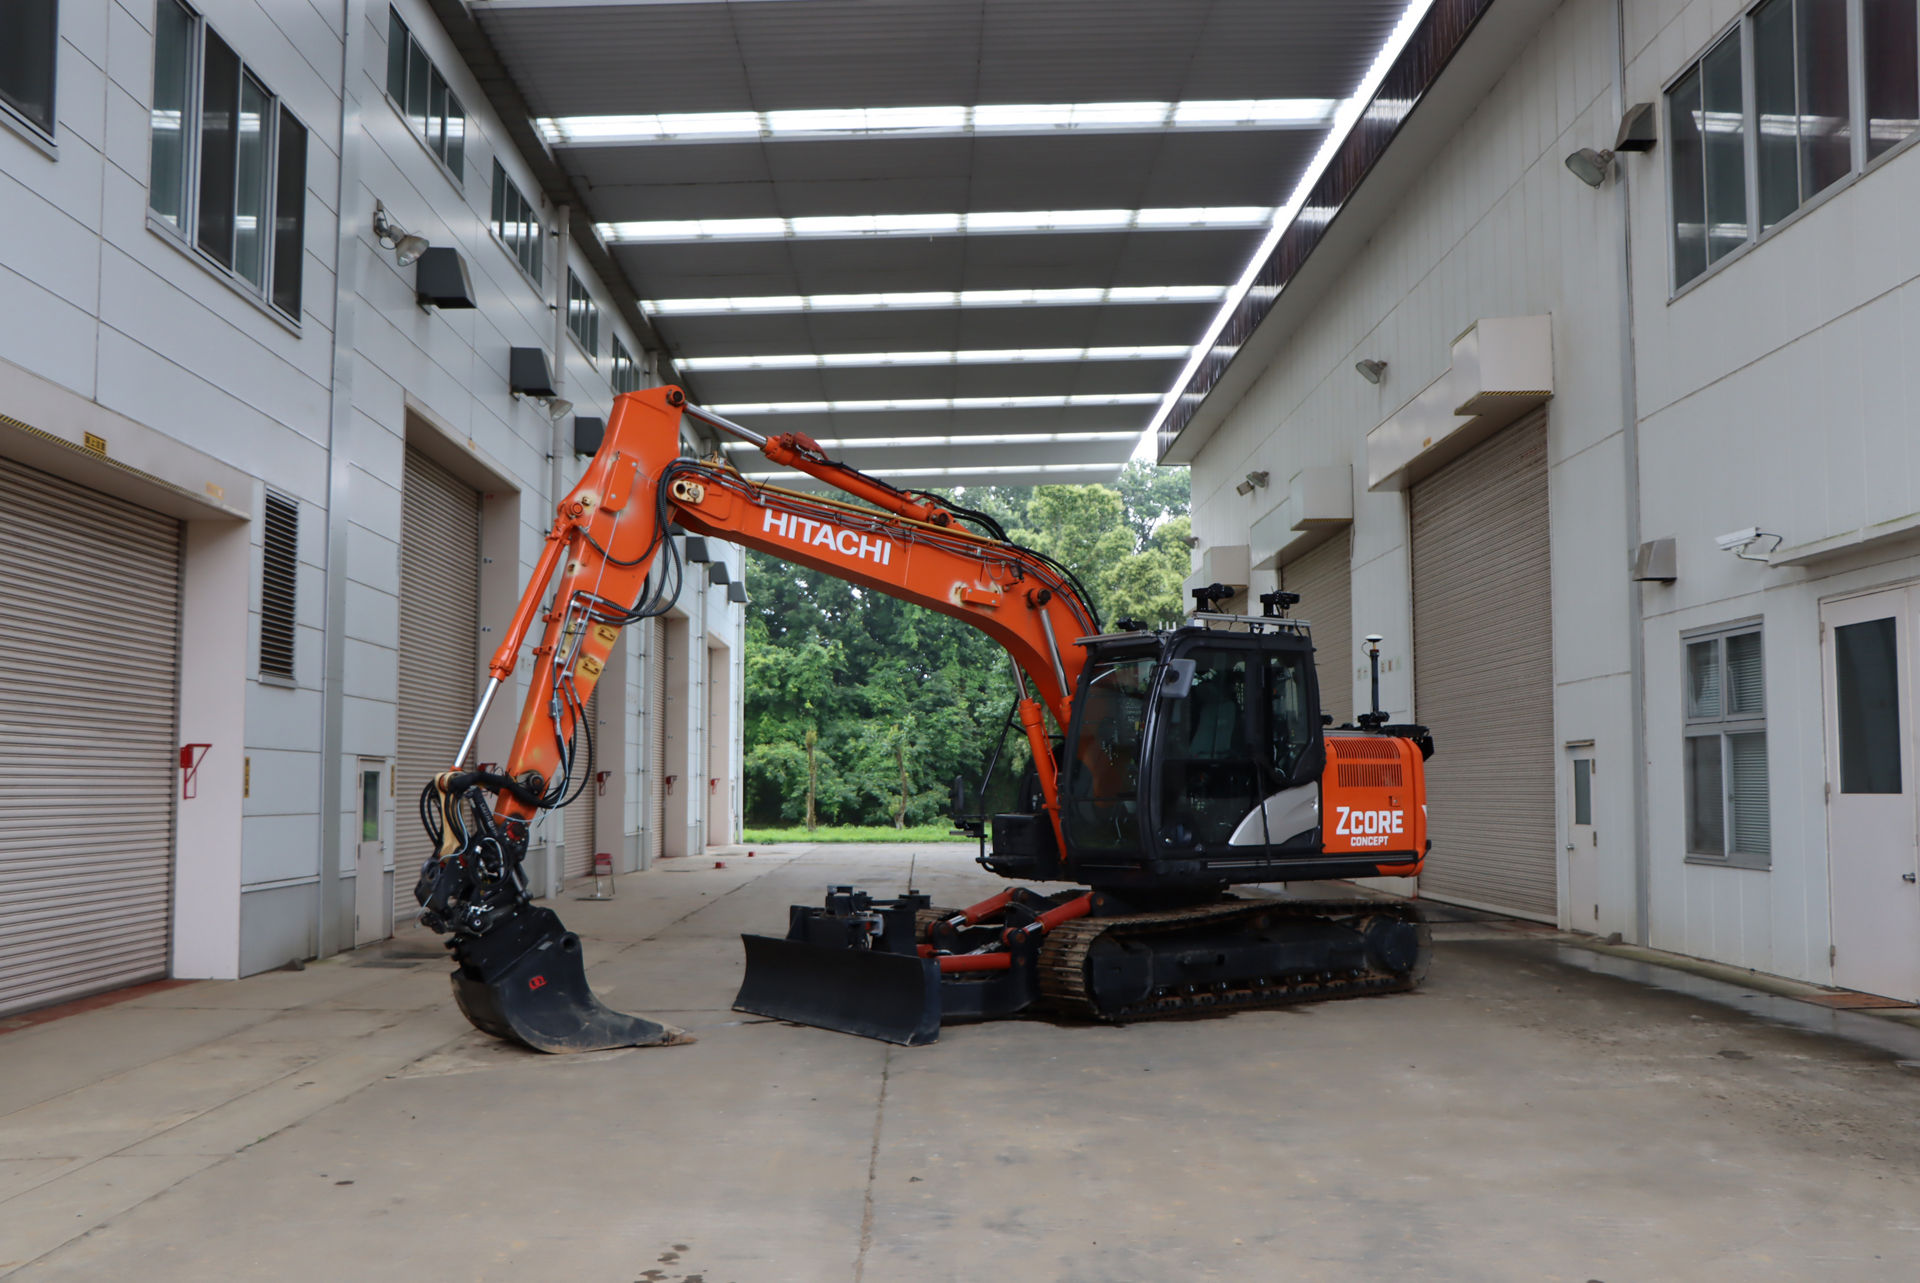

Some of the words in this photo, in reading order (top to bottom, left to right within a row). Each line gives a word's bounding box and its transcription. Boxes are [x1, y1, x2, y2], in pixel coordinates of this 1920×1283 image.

[762, 508, 892, 566] HITACHI
[1335, 806, 1404, 835] ZCORE
[1350, 836, 1389, 847] CONCEPT
